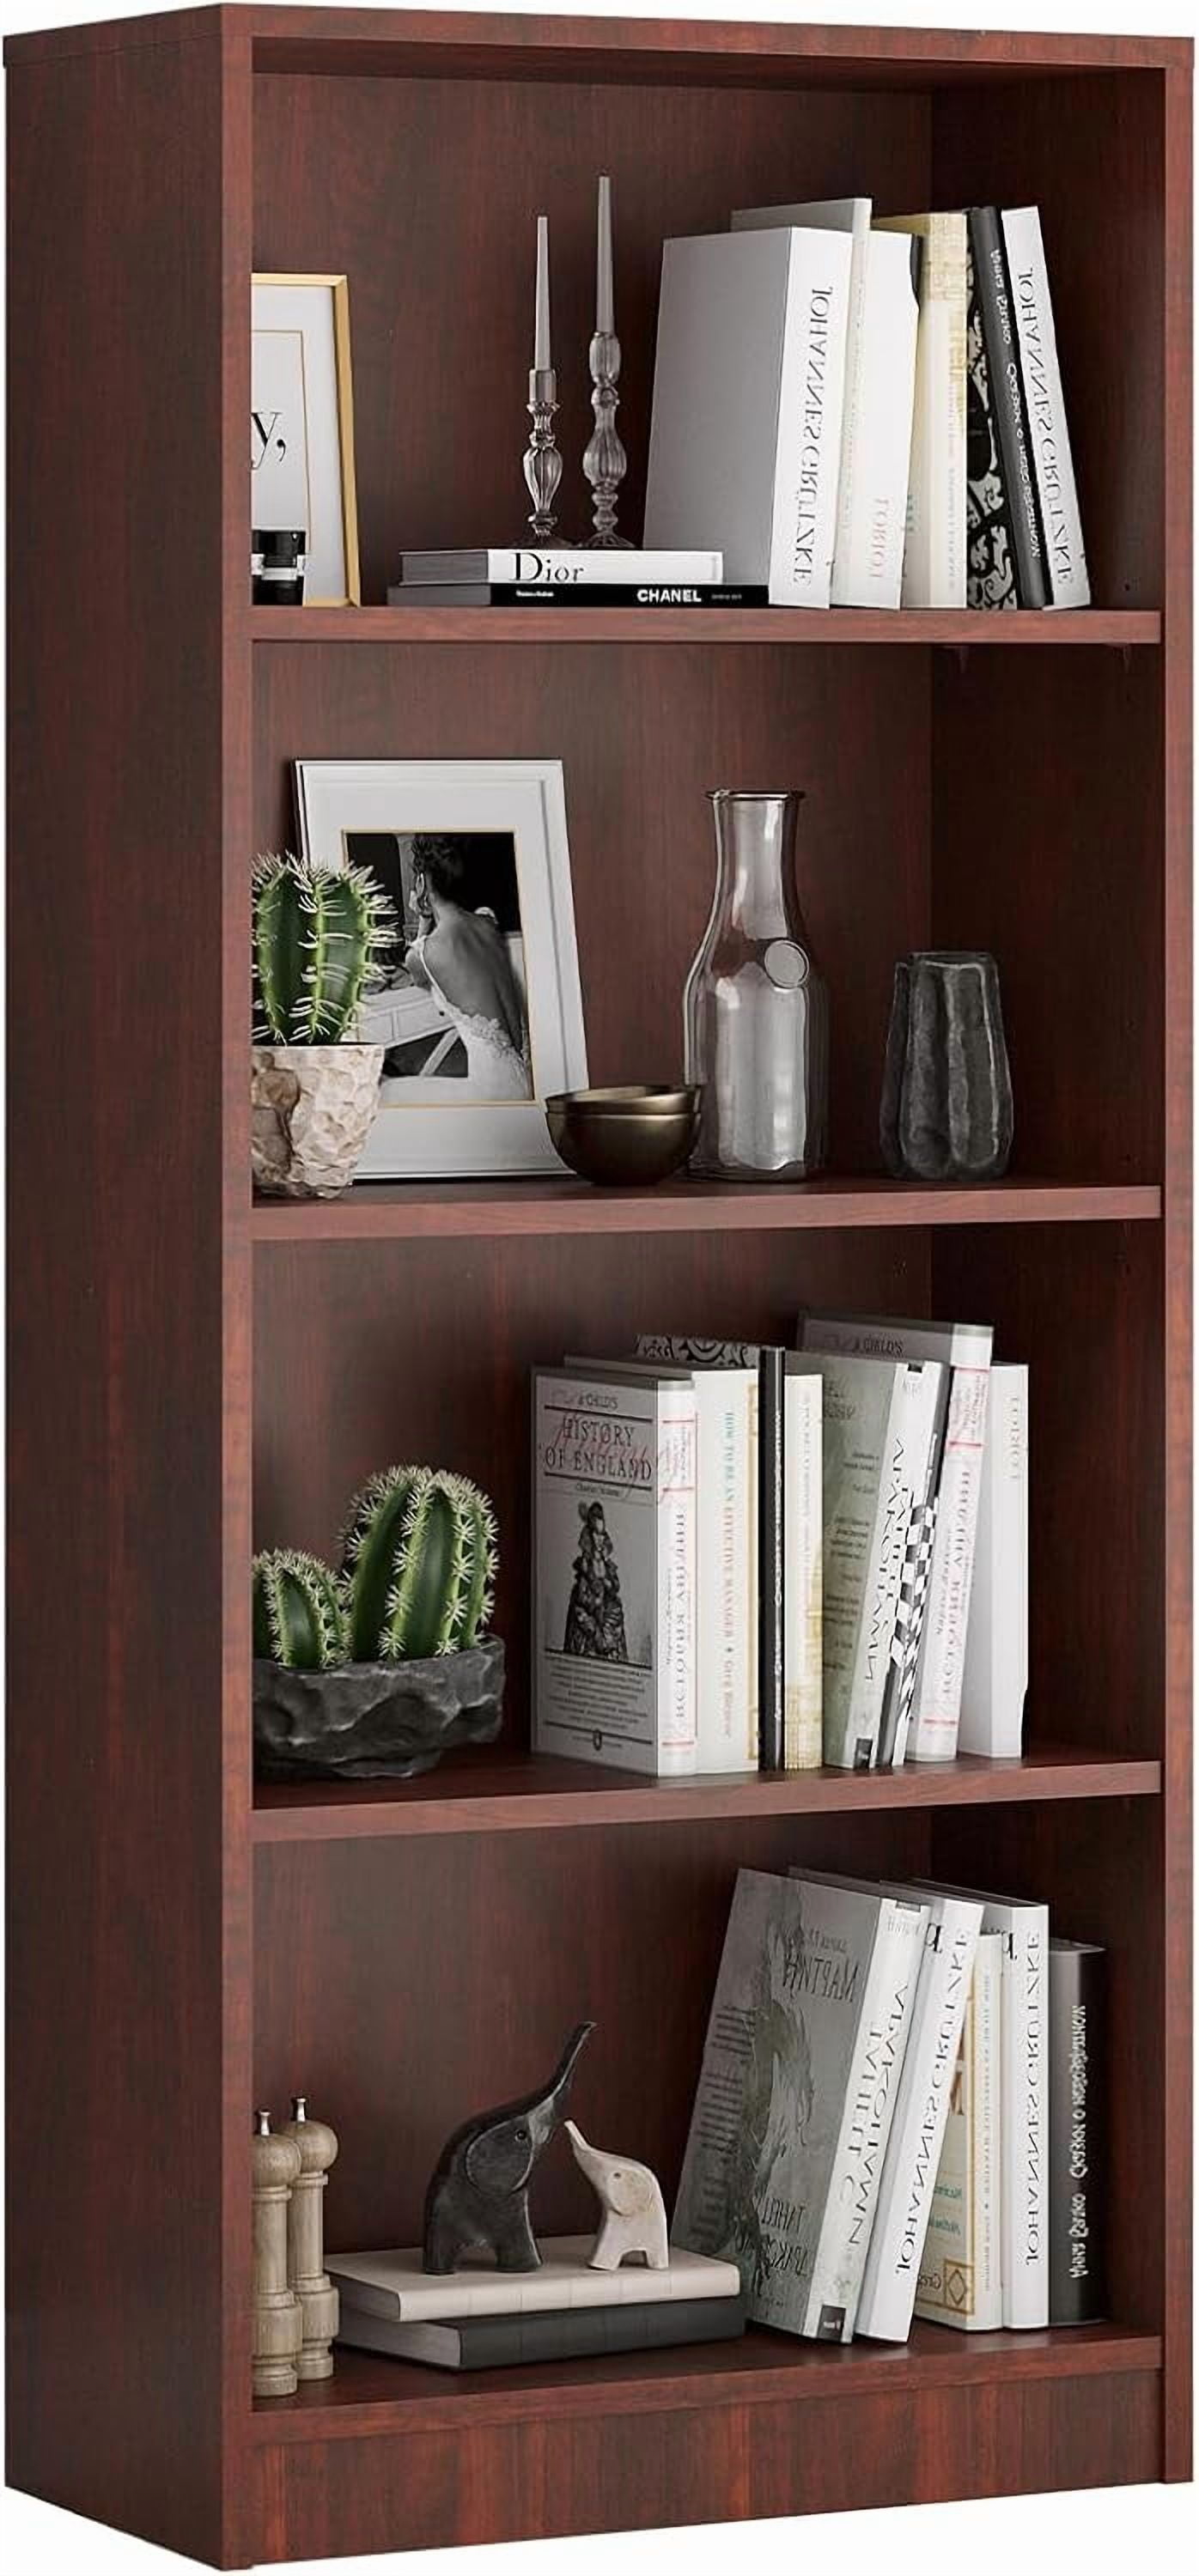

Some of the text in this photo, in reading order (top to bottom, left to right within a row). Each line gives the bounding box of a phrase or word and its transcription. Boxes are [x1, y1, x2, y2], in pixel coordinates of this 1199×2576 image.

[513, 551, 584, 582] Dior
[636, 587, 703, 603] CHANEL
[563, 1413, 636, 1448] HISTORY
[573, 1449, 653, 1481] ENGLAND
